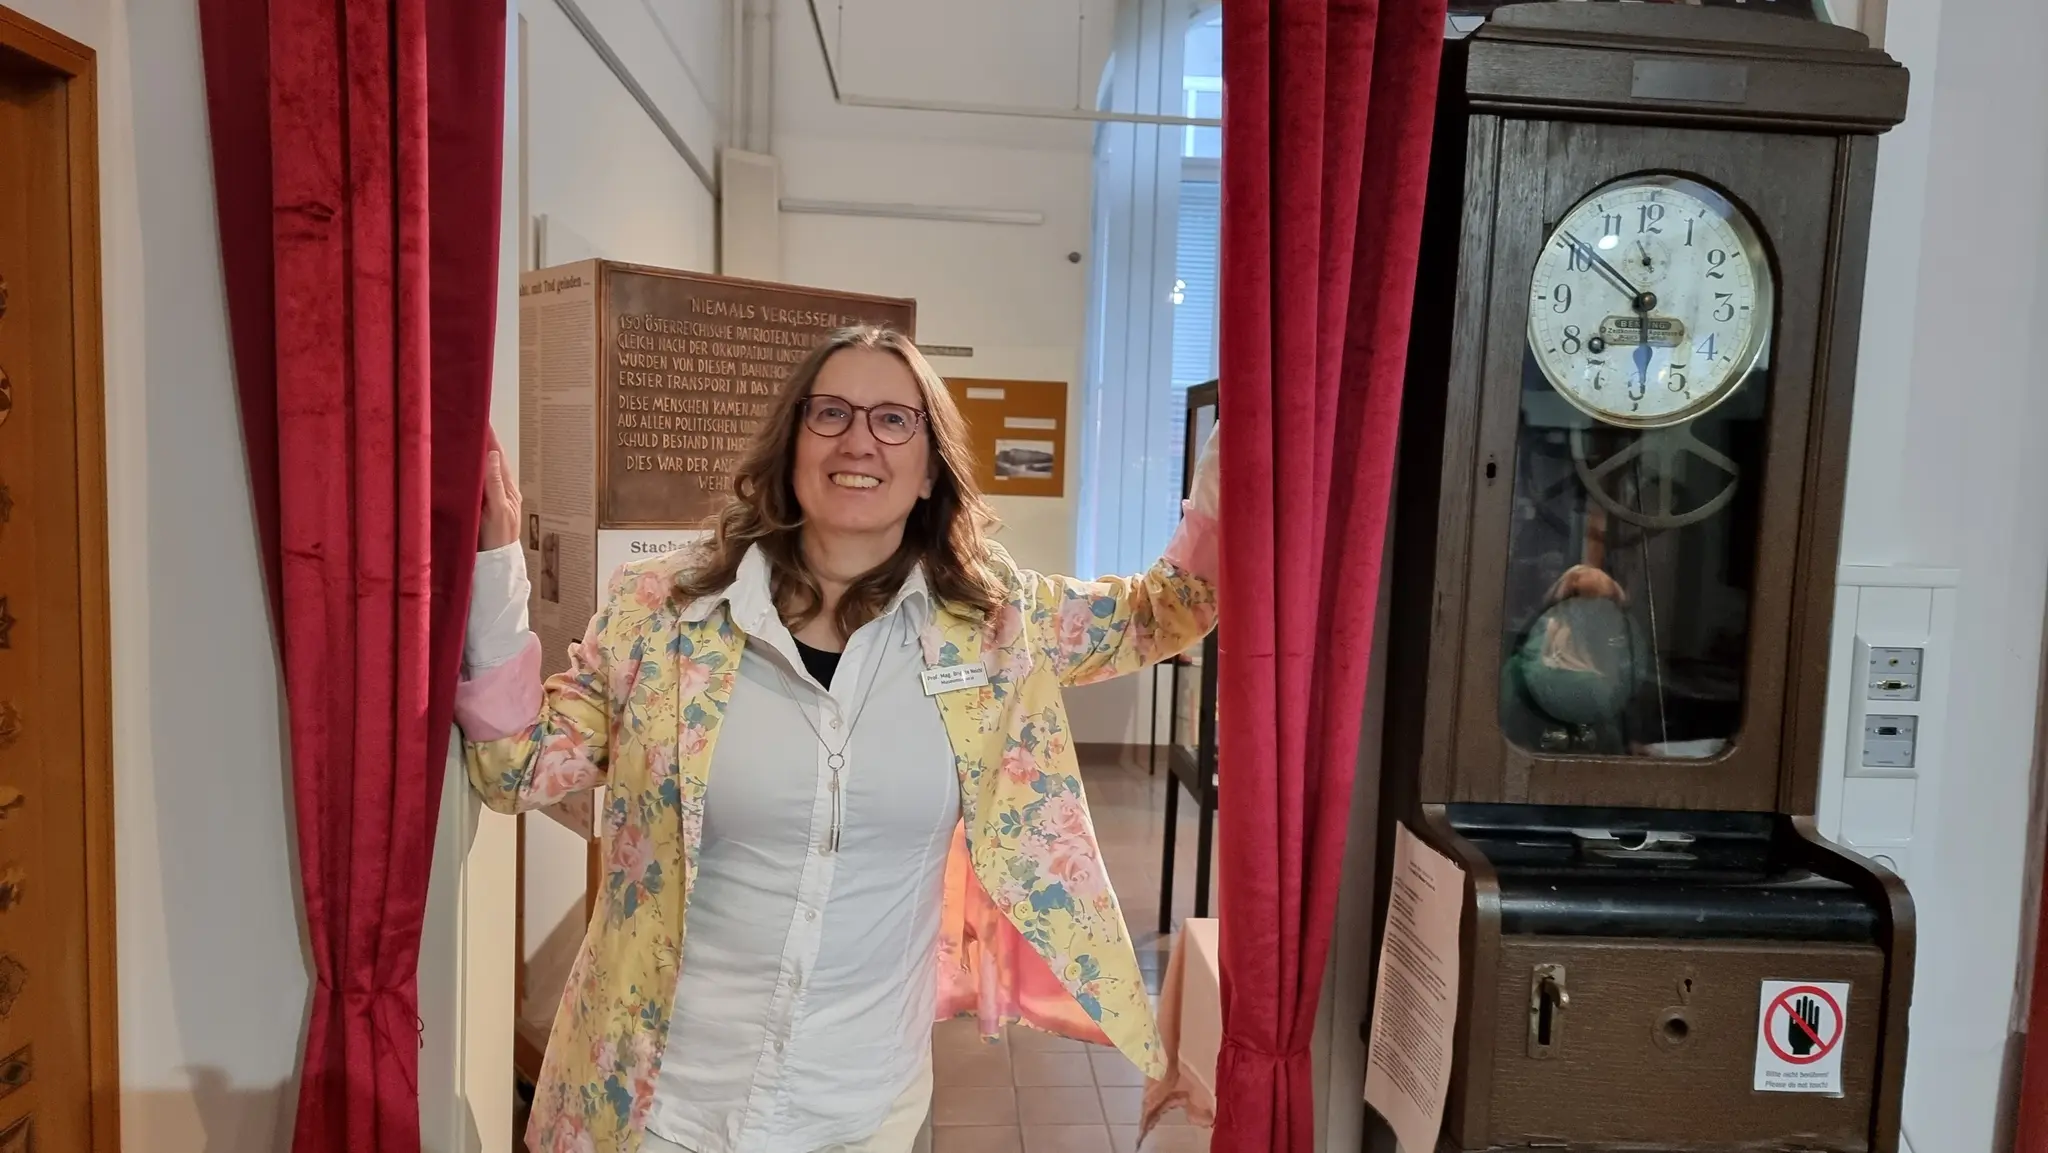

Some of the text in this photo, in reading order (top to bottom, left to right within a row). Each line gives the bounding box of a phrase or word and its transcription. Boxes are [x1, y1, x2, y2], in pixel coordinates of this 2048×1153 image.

[1602, 213, 1622, 236] 11
[1637, 204, 1665, 234] 12
[1684, 218, 1694, 246] 1
[1567, 242, 1592, 273] 10
[1706, 249, 1726, 279] 2
[691, 298, 756, 319] NIEMALS
[760, 306, 838, 328] VERGESSEN
[1553, 284, 1572, 314] 9
[1713, 292, 1734, 322] 3
[619, 314, 641, 330] 150
[644, 313, 734, 340] ÖSTERREICHISCHE
[1561, 325, 1581, 354] 8
[617, 332, 655, 350] GLEICH
[658, 337, 686, 353] NACH
[689, 340, 709, 355] DER
[712, 342, 773, 361] OKKUPATION
[1696, 333, 1718, 361] 4
[618, 352, 668, 371] WURDEN
[672, 356, 694, 373] VON
[698, 359, 737, 376] DIESEM
[1667, 363, 1687, 392] 5
[619, 370, 663, 389] ERSTER
[667, 374, 731, 393] TRANSPORT
[736, 380, 747, 395] IN
[751, 381, 769, 395] DAS
[618, 395, 649, 411] DIESE
[652, 398, 709, 415] MENSCHEN
[713, 400, 749, 416] KAMEN
[617, 413, 637, 428] AUS
[640, 415, 672, 430] ALLEN
[675, 417, 737, 433] POLITISCHEN
[617, 432, 659, 448] SCHULD
[662, 434, 709, 450] BESTAND
[711, 436, 724, 451] IN
[626, 455, 653, 472] DIES
[657, 455, 684, 472] WAR
[687, 456, 709, 472] DER
[1782, 1070, 1798, 1078] nicht
